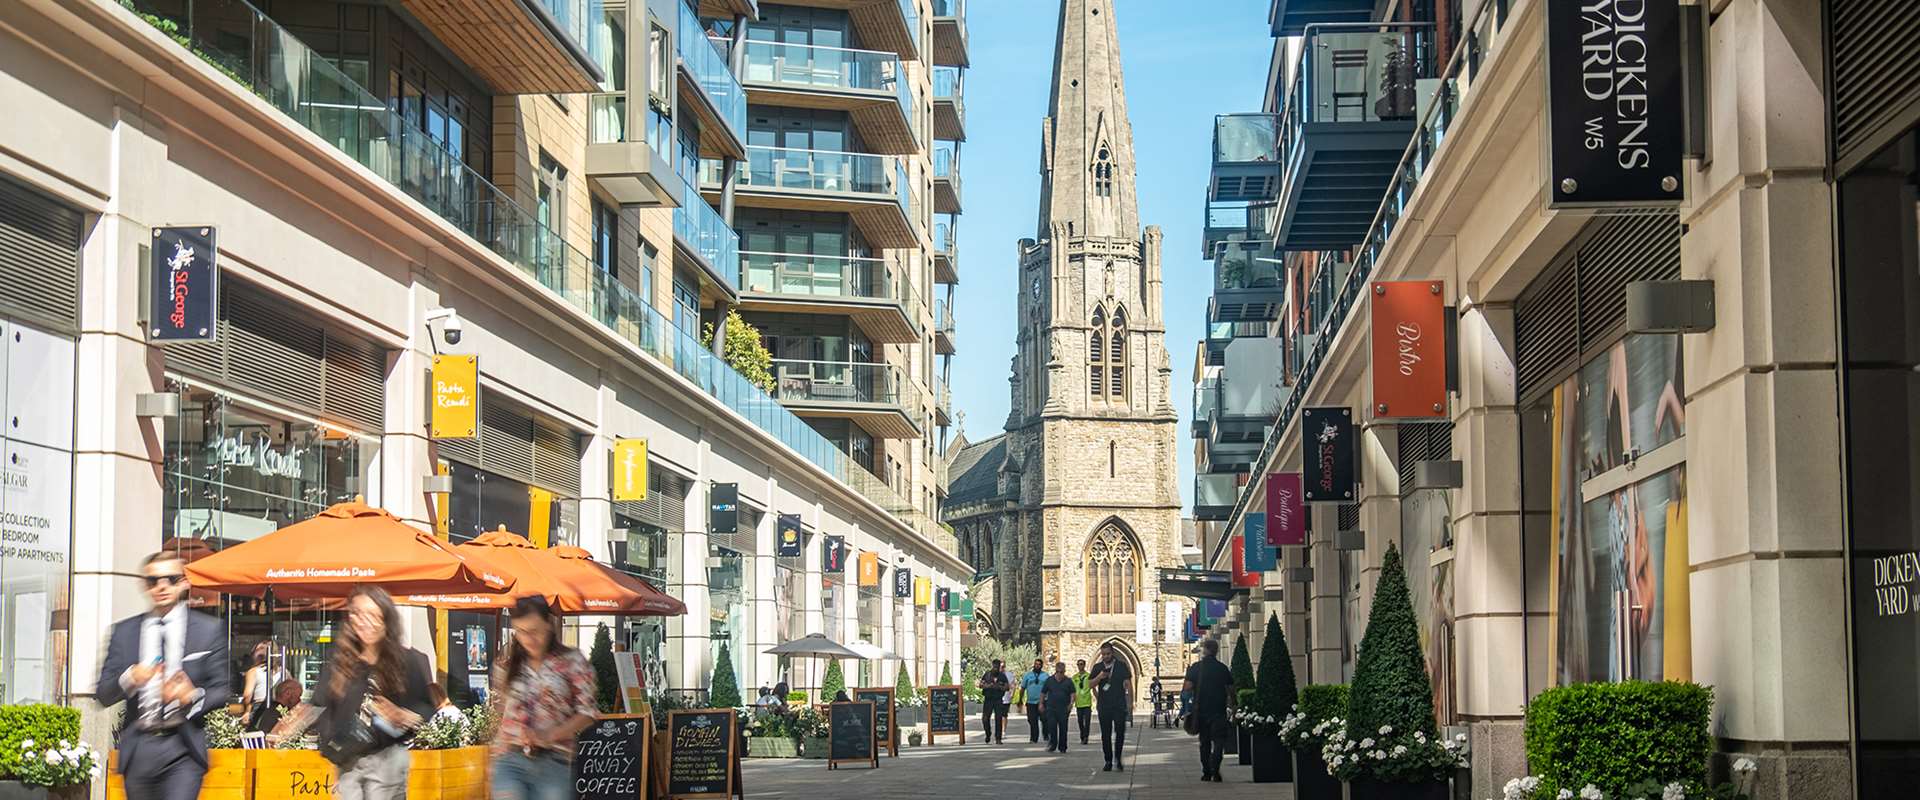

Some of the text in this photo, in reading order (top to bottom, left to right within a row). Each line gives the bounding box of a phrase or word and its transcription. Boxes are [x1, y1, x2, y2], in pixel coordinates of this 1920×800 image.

[1580, 0, 1614, 150] YARD W5
[1614, 0, 1650, 170] DICKENS
[170, 284, 189, 329] George
[1396, 322, 1422, 376] Bistro
[1320, 456, 1335, 492] George
[5, 512, 50, 528] COLLECTION
[3, 529, 39, 544] BEDROOM
[17, 548, 64, 563] APARTMENTS
[306, 567, 351, 577] Homemade
[351, 566, 376, 577] Pasta
[1875, 585, 1909, 616] YARD
[578, 740, 628, 756] TAKE
[583, 756, 636, 774] AWAY
[575, 777, 636, 794] COFFEE
